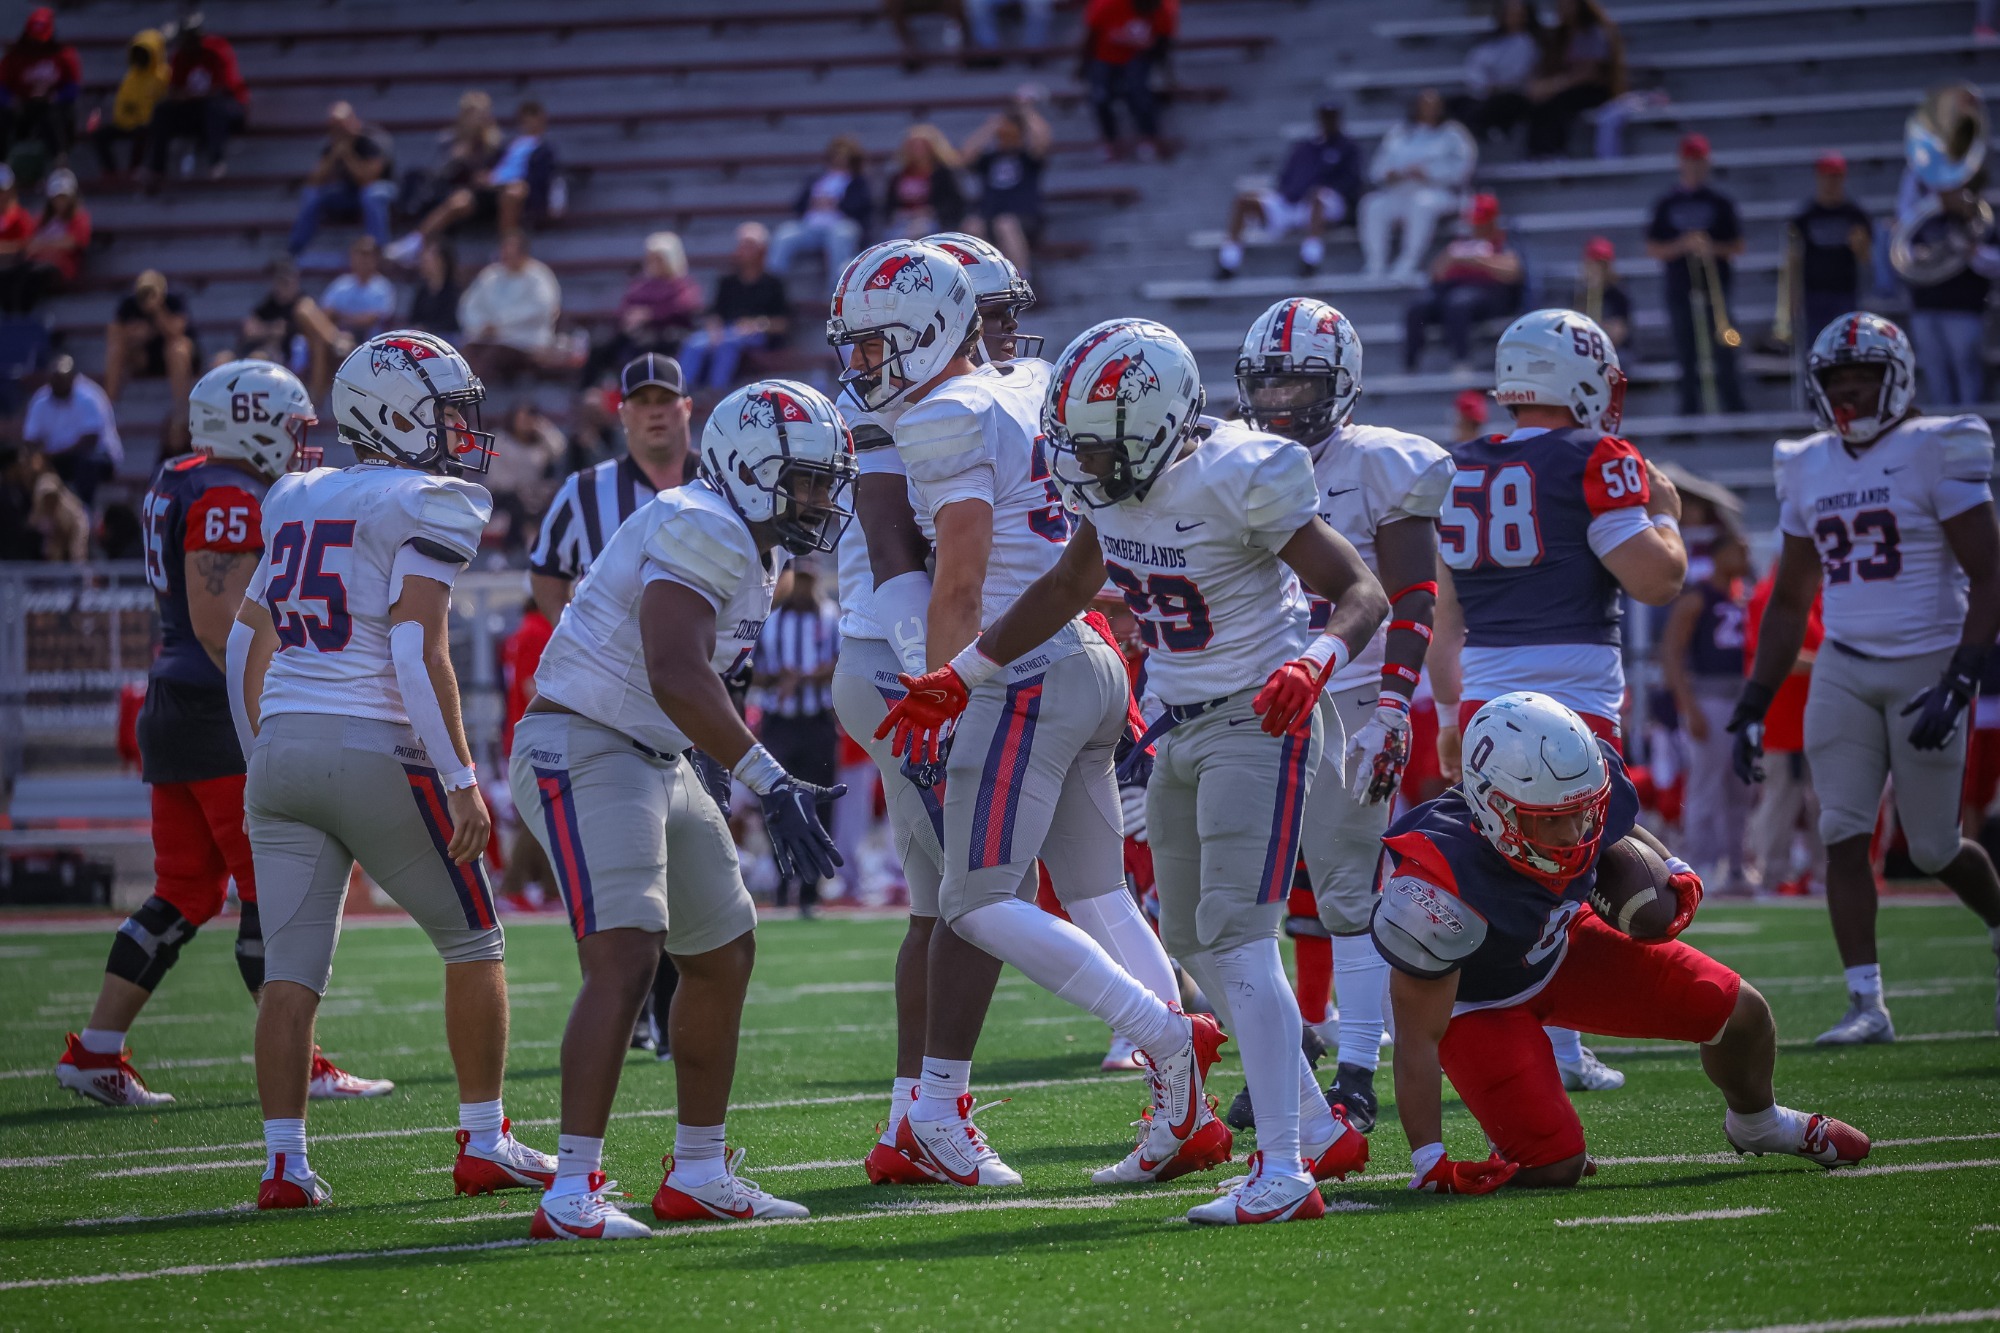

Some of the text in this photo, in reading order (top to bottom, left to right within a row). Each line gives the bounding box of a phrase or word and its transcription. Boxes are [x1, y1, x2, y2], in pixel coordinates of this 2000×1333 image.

[1570, 327, 1605, 362] 58
[231, 393, 270, 424] 65
[1602, 455, 1642, 499] 58
[205, 506, 249, 544] 65
[1438, 461, 1545, 570] 58
[1815, 508, 1902, 584] 23
[266, 519, 357, 652] 25
[1012, 654, 1050, 676] PATRIOTS
[394, 745, 426, 761] PATRIOTS
[530, 748, 563, 764] PATRIOTS
[1563, 788, 1592, 803] Riddell
